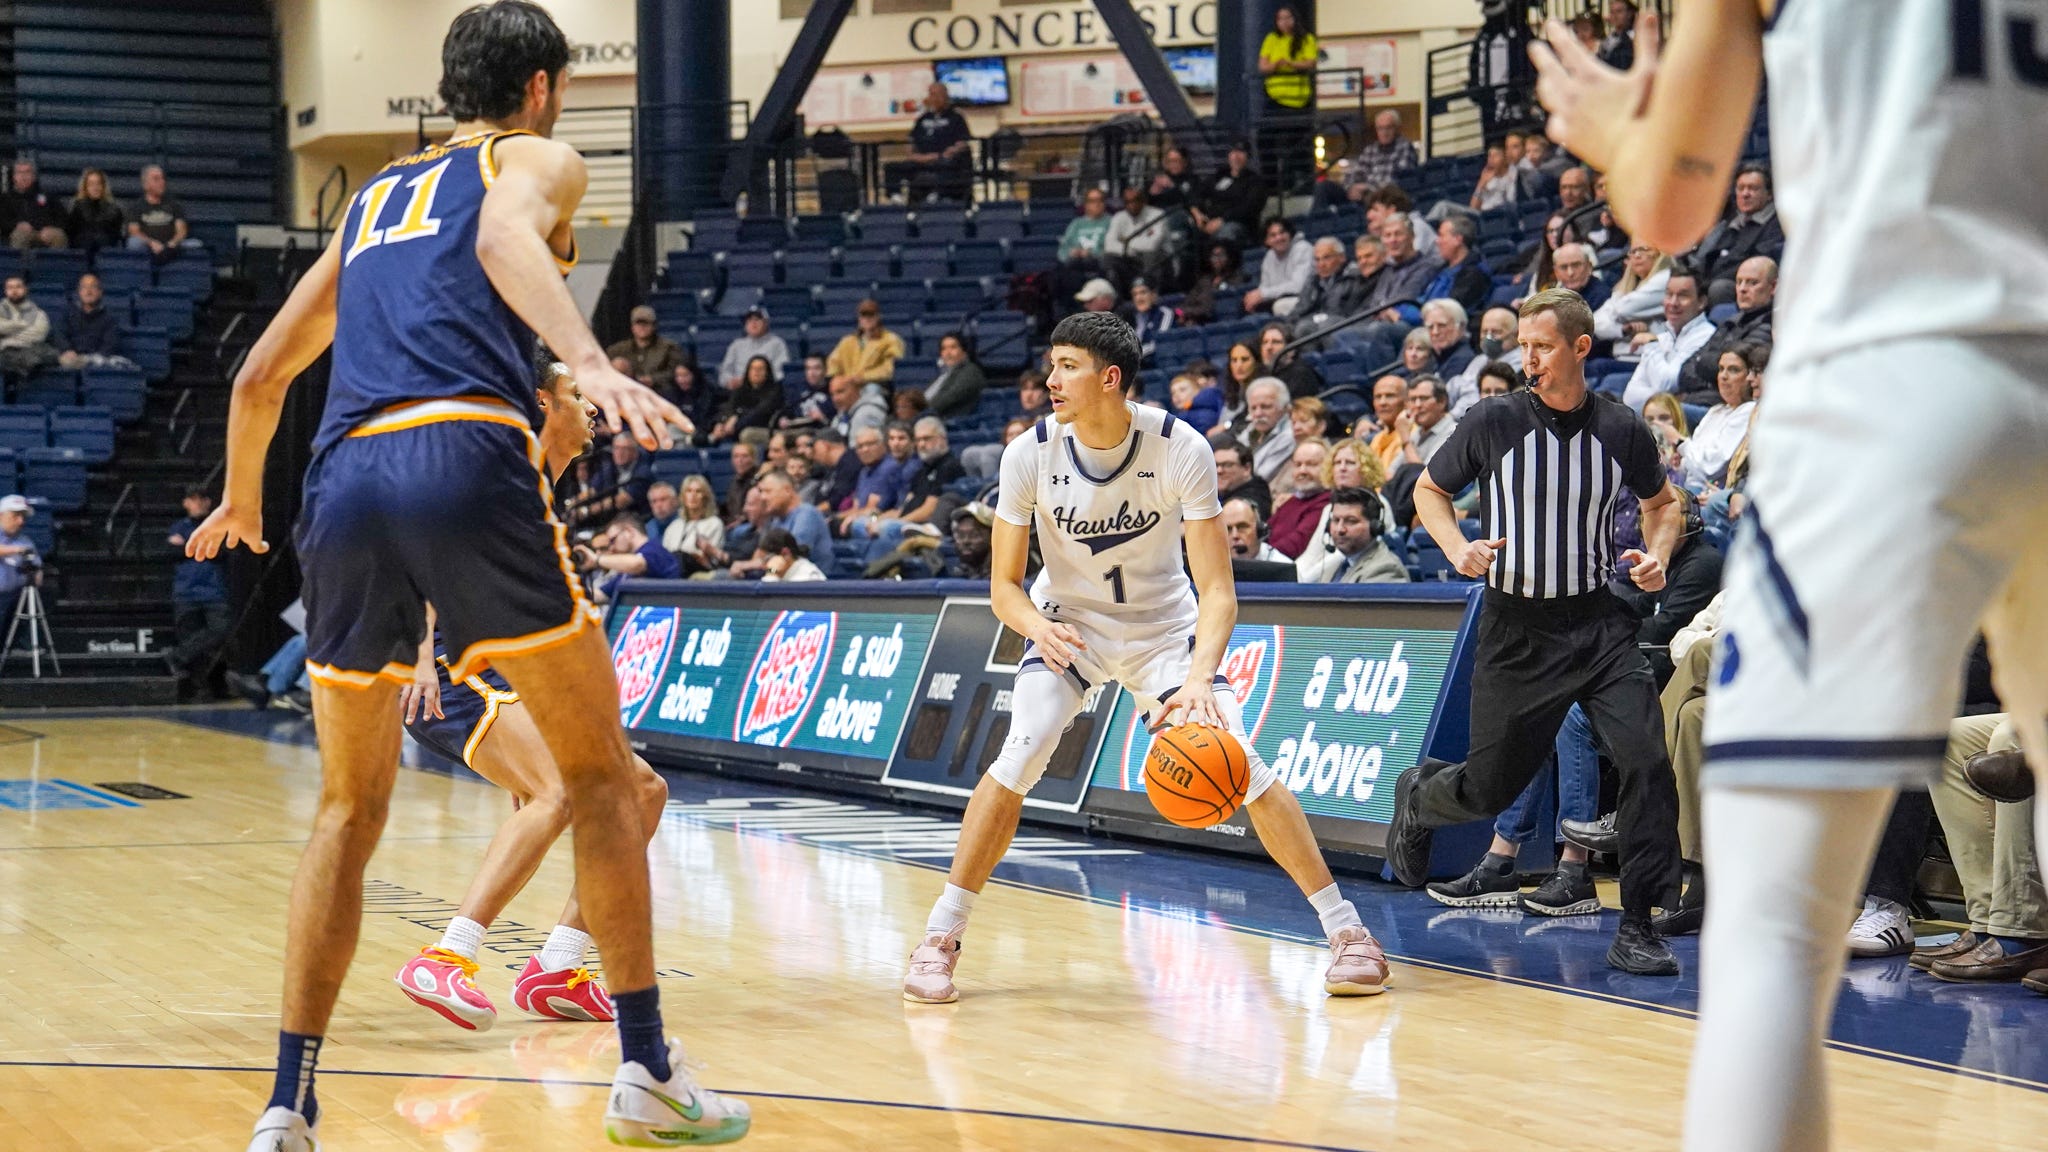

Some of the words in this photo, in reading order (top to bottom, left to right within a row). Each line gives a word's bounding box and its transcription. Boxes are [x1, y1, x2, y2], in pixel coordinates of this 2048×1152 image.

[908, 2, 1217, 52] CONCESIO
[344, 157, 453, 267] 11
[1137, 471, 1155, 479] CAA
[1053, 500, 1161, 535] Hawks
[1103, 564, 1128, 604] 1
[138, 628, 154, 653] F
[681, 628, 700, 664] a
[694, 616, 732, 667] sub
[841, 635, 863, 675] a
[858, 622, 903, 678] sub
[926, 672, 961, 701] HOME
[1303, 654, 1333, 711] a
[1334, 640, 1409, 715] sub
[816, 683, 883, 743] above
[1150, 744, 1194, 790] Wilson
[1270, 720, 1383, 803] above
